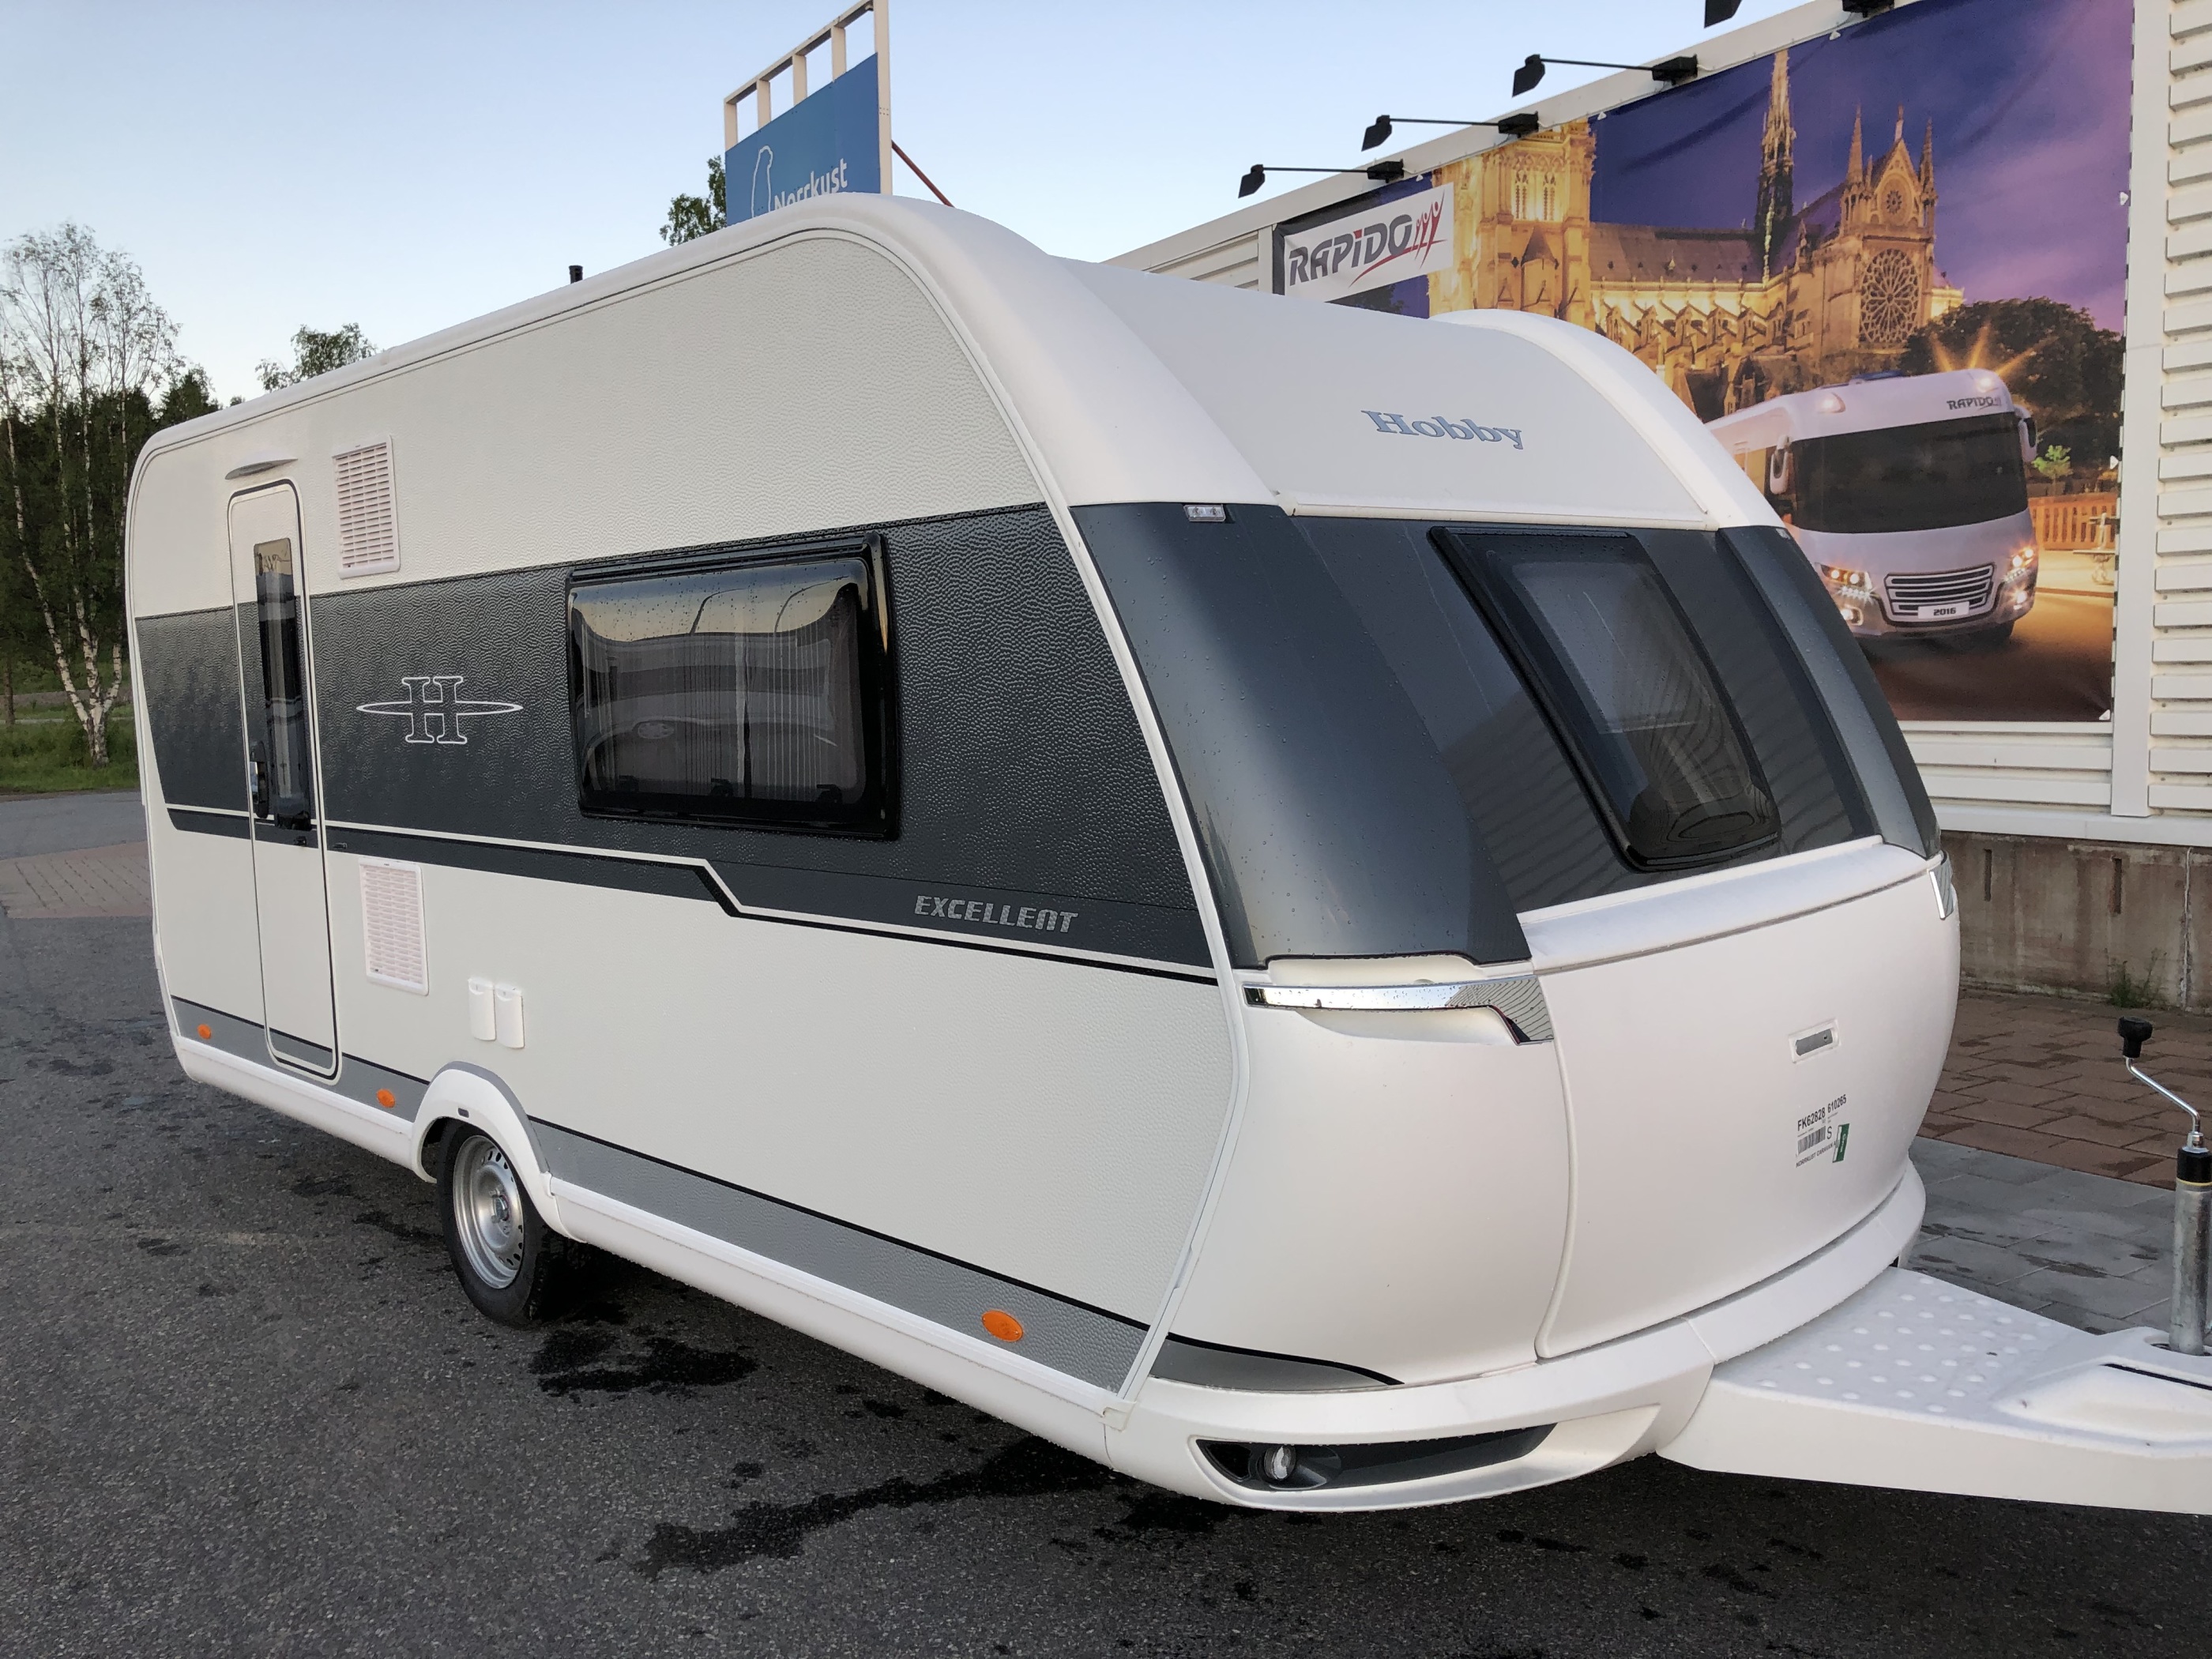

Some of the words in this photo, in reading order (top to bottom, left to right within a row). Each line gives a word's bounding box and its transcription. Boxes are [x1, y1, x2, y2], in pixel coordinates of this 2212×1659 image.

[774, 158, 848, 210] Norrkust
[1288, 214, 1413, 286] RAPIDO
[1947, 397, 1994, 410] RAPIDO
[1360, 410, 1523, 450] Hobby
[914, 895, 1078, 933] EXCELLENT
[1797, 1107, 1826, 1131] FK62828
[1827, 1094, 1847, 1113] 610265
[1827, 1126, 1832, 1140] S
